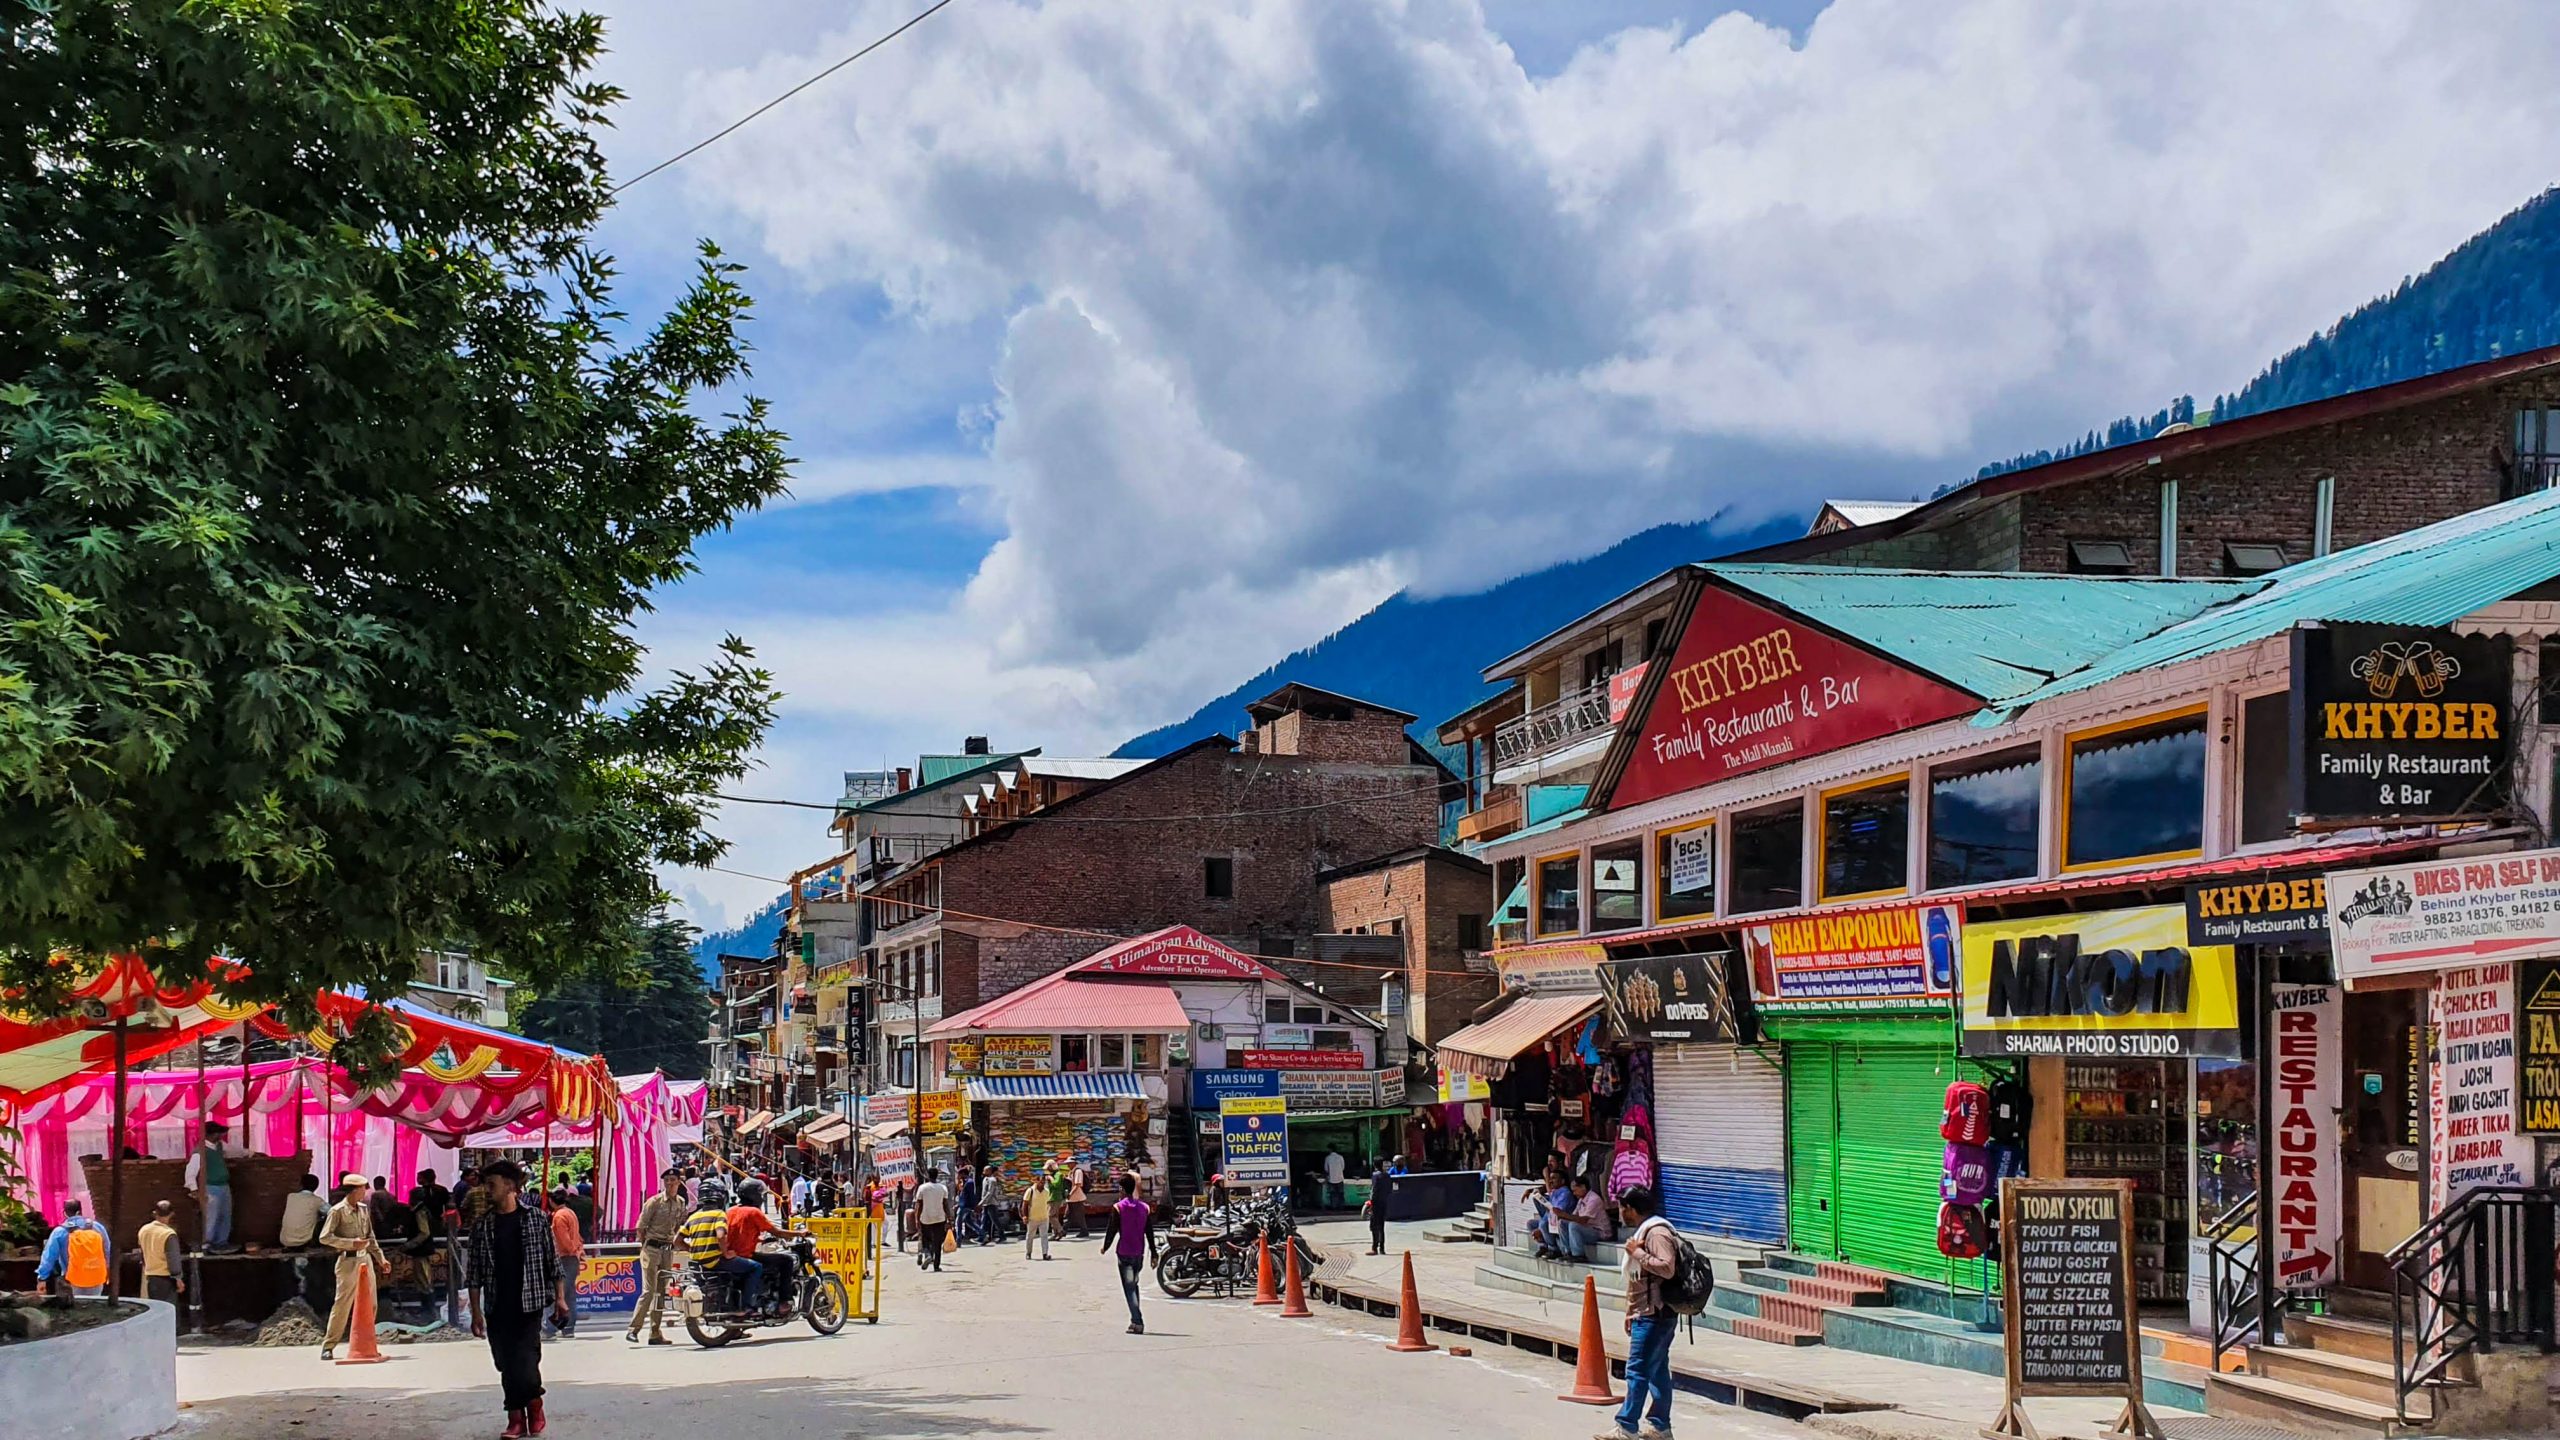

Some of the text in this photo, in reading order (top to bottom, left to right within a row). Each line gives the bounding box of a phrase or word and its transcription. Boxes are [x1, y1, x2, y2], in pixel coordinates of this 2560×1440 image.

[1670, 628, 1802, 714] KHYBER
[1652, 675, 1861, 764] Family Restaurant & Bar
[2324, 703, 2499, 739] KHYBER
[1722, 736, 1794, 769] The Mall Manali
[2320, 753, 2491, 780] Family Restaurant
[2379, 784, 2432, 805] & Bar
[1679, 839, 1702, 857] BCS
[2413, 868, 2461, 897] BIKES
[2464, 864, 2496, 891] FOR
[2499, 858, 2537, 888] SELF
[2420, 898, 2466, 912] Behind
[2470, 892, 2516, 910] Khyber
[2424, 911, 2462, 926] 98823
[2511, 901, 2550, 916] 94182
[1771, 908, 1921, 956] SHAH EMPORIUM
[2205, 920, 2240, 939] Family
[2243, 916, 2306, 934] Restaurant
[2308, 914, 2319, 929] &
[2389, 931, 2413, 944] RIVER
[2505, 916, 2545, 932] TREKKING
[1118, 934, 1249, 973] Himalayan Adventures
[1159, 953, 1210, 966] OFFICE
[1140, 964, 1228, 975] Adventure Tour Operators
[1986, 933, 2192, 1017] Nikon
[2271, 989, 2330, 1009] KHYBER
[2445, 990, 2497, 1015] CHICKEN
[1665, 1002, 1709, 1020] 100 PIPERS
[2475, 1012, 2510, 1035] CHICKEN
[2529, 1014, 2560, 1053] FA
[2005, 1034, 2180, 1053] SHARMA PHOTO STUDIO
[1258, 1053, 1268, 1061] The
[1342, 1055, 1362, 1064] Society
[1206, 1074, 1264, 1084] SAMSUNG
[1285, 1073, 1371, 1083] SHARMA PUNJABI DHABA
[2459, 1066, 2493, 1088] JOSH
[1214, 1090, 1256, 1099] Galaxy
[2472, 1088, 2510, 1110] GOSHT
[2280, 1012, 2317, 1250] RESTAURANT
[2482, 1113, 2510, 1133] TIKKA
[1226, 1131, 1283, 1143] ONE WAY
[1228, 1144, 1282, 1154] TRAFFIC
[880, 1163, 897, 1176] SNOW
[1960, 1163, 1985, 1180] RUN
[2503, 1163, 2515, 1171] UP
[2021, 1197, 2115, 1220] TODAY SPECIAL
[822, 1226, 852, 1234] WELCOE
[2022, 1225, 2099, 1237] TROUT FISH
[2022, 1241, 2117, 1253] BUTTER CHICKEN
[2282, 1250, 2293, 1260] UP
[595, 1261, 633, 1276] FOR
[2023, 1257, 2109, 1269] HANDI GOSHT
[576, 1278, 636, 1295] CKING
[2023, 1272, 2111, 1284] CHILLY CHICKEN
[2025, 1288, 2109, 1300] MIX SIZZLER
[2025, 1304, 2113, 1316] CHICKEN TIKKA
[2025, 1320, 2122, 1331] BUTTER FRY PASTA
[2072, 1335, 2103, 1346] SHOT
[2026, 1350, 2104, 1360] DAL MAKHANI
[2025, 1363, 2122, 1378] TANDOORI CHICKEN
